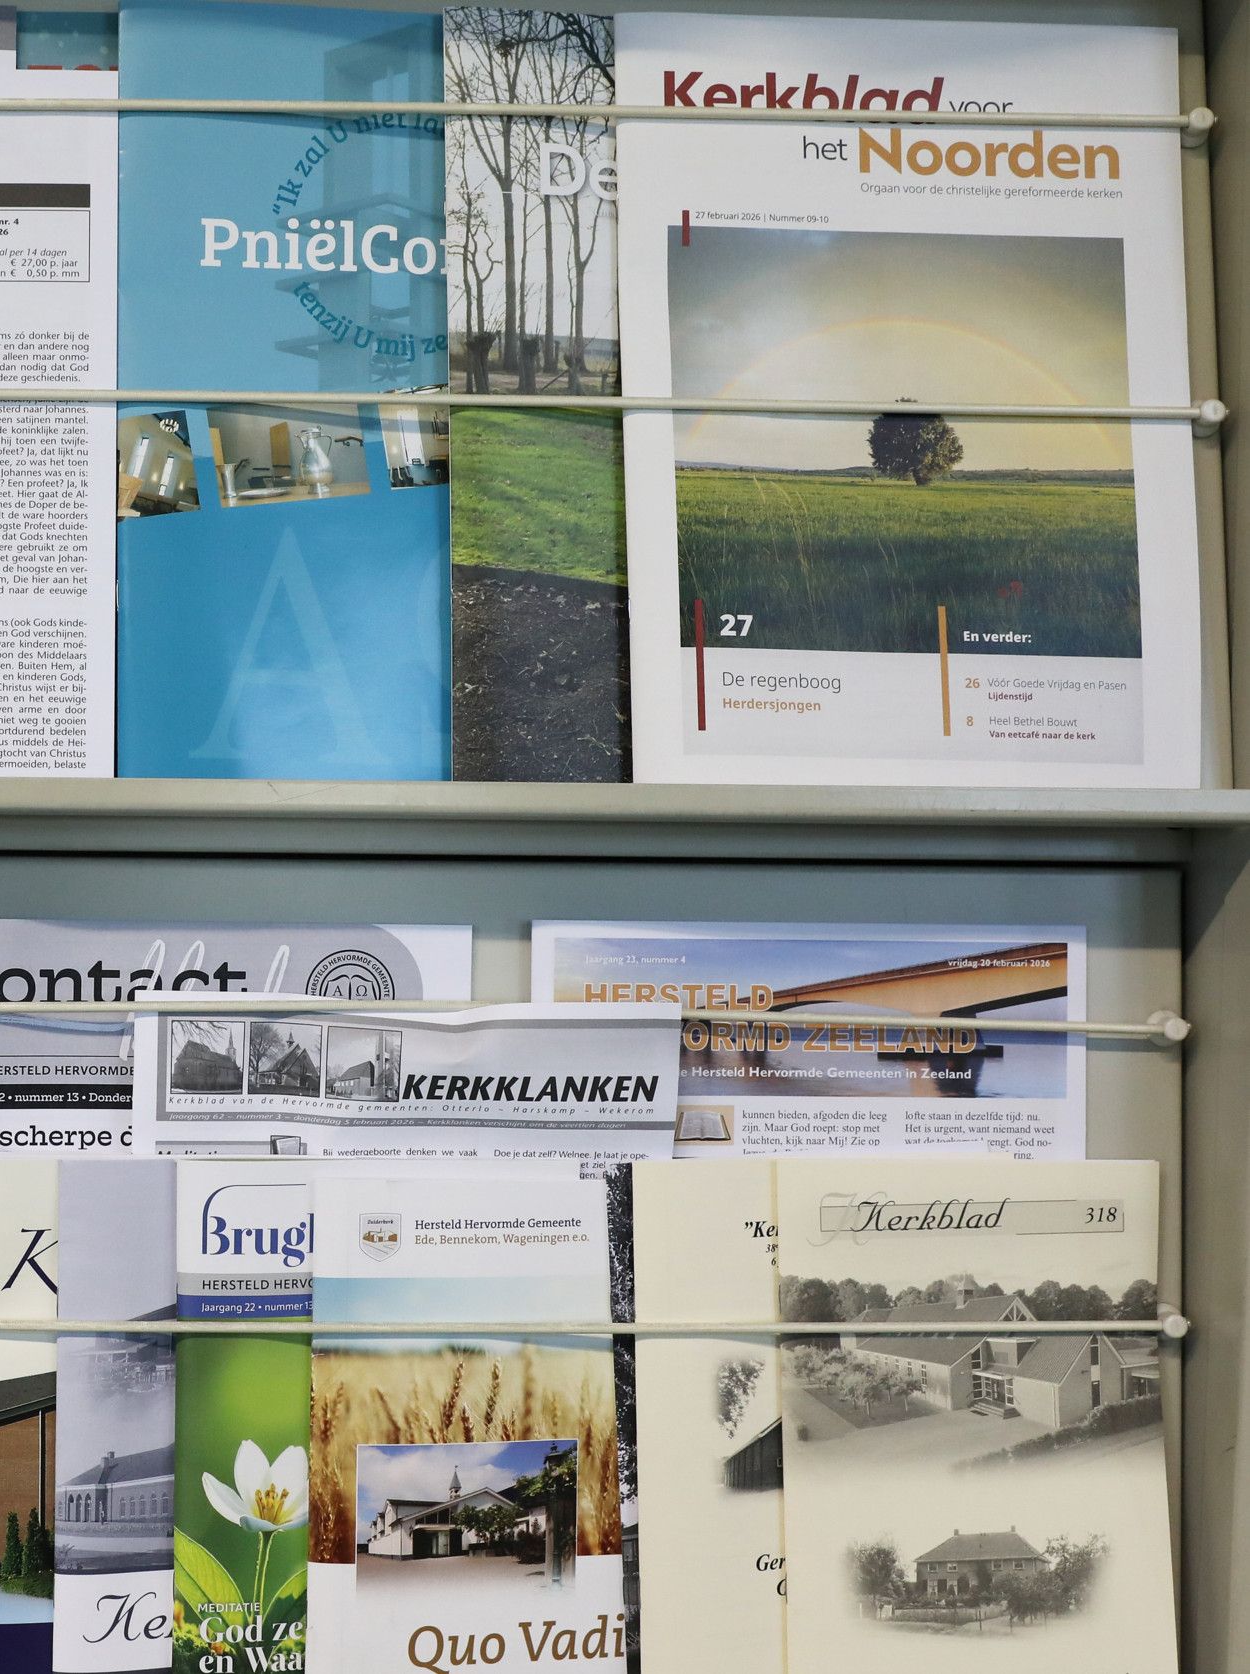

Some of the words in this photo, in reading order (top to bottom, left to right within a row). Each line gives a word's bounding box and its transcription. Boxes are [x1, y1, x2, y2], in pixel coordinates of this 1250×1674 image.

[663, 70, 944, 125] Kerkblad
[296, 138, 330, 179] zal
[327, 119, 350, 145] U
[802, 135, 848, 163] het
[858, 127, 1120, 180] Noorden
[859, 181, 901, 196] Orgaan
[902, 184, 927, 194] voor
[928, 183, 944, 195] de
[945, 183, 1002, 199] christelijke
[1003, 185, 1085, 200] gereformeerde
[1086, 187, 1123, 199] kerken
[694, 210, 706, 219] 27
[706, 210, 740, 220] februari
[740, 211, 761, 222] 2026
[768, 213, 805, 223] Nummer
[805, 214, 829, 224] 09-10
[200, 217, 447, 276] PniëlCo
[293, 279, 353, 340] tenzij
[351, 324, 372, 351] U
[375, 336, 418, 362] mij
[718, 612, 755, 639] 27
[962, 630, 979, 642] En
[981, 630, 1032, 644] verder:
[721, 670, 745, 687] De
[749, 672, 841, 694] regenboog
[963, 675, 981, 691] 26
[986, 677, 1011, 688] Vóór
[1012, 677, 1045, 689] Goede
[1046, 678, 1081, 692] Vrijdag
[1082, 681, 1096, 690] en
[1097, 679, 1127, 691] Pasen
[722, 696, 821, 714] Herdersjongen
[987, 691, 1033, 703] Lijdenstijd
[965, 713, 975, 729] 8
[988, 715, 1011, 726] Heel
[1012, 715, 1045, 727] Bethel
[1046, 716, 1078, 728] Bouwt
[988, 729, 1006, 739] Van
[1007, 730, 1040, 739] eetcafé
[1063, 730, 1075, 740] de
[1075, 731, 1096, 740] kerk
[583, 982, 774, 1013] HERSTELD
[802, 1023, 977, 1055] ZEELAND
[690, 1065, 745, 1077] Hersteld
[748, 1065, 824, 1078] Hervormde
[826, 1066, 902, 1078] Gemeenten
[905, 1067, 917, 1079] in
[919, 1067, 972, 1080] Zeeland
[401, 1074, 659, 1102] KERKKLANKEN
[741, 1108, 775, 1120] kunnen
[776, 1109, 811, 1121] bieden,
[812, 1109, 850, 1122] afgoden
[850, 1110, 866, 1120] die
[868, 1110, 887, 1123] leeg
[414, 1218, 462, 1230] Hersteld
[463, 1217, 525, 1230] Hervormde
[526, 1217, 582, 1228] Gemeente
[851, 1197, 1011, 1233] Kerkblad
[1083, 1204, 1119, 1226] 318
[413, 1233, 437, 1246] Ede,
[438, 1232, 501, 1245] Bennekom,
[501, 1232, 570, 1247] Wageningen
[571, 1233, 590, 1242] e.o.
[196, 1600, 262, 1614] MEDITATIE
[408, 1625, 506, 1673] Quo
[518, 1612, 625, 1662] Vadi
